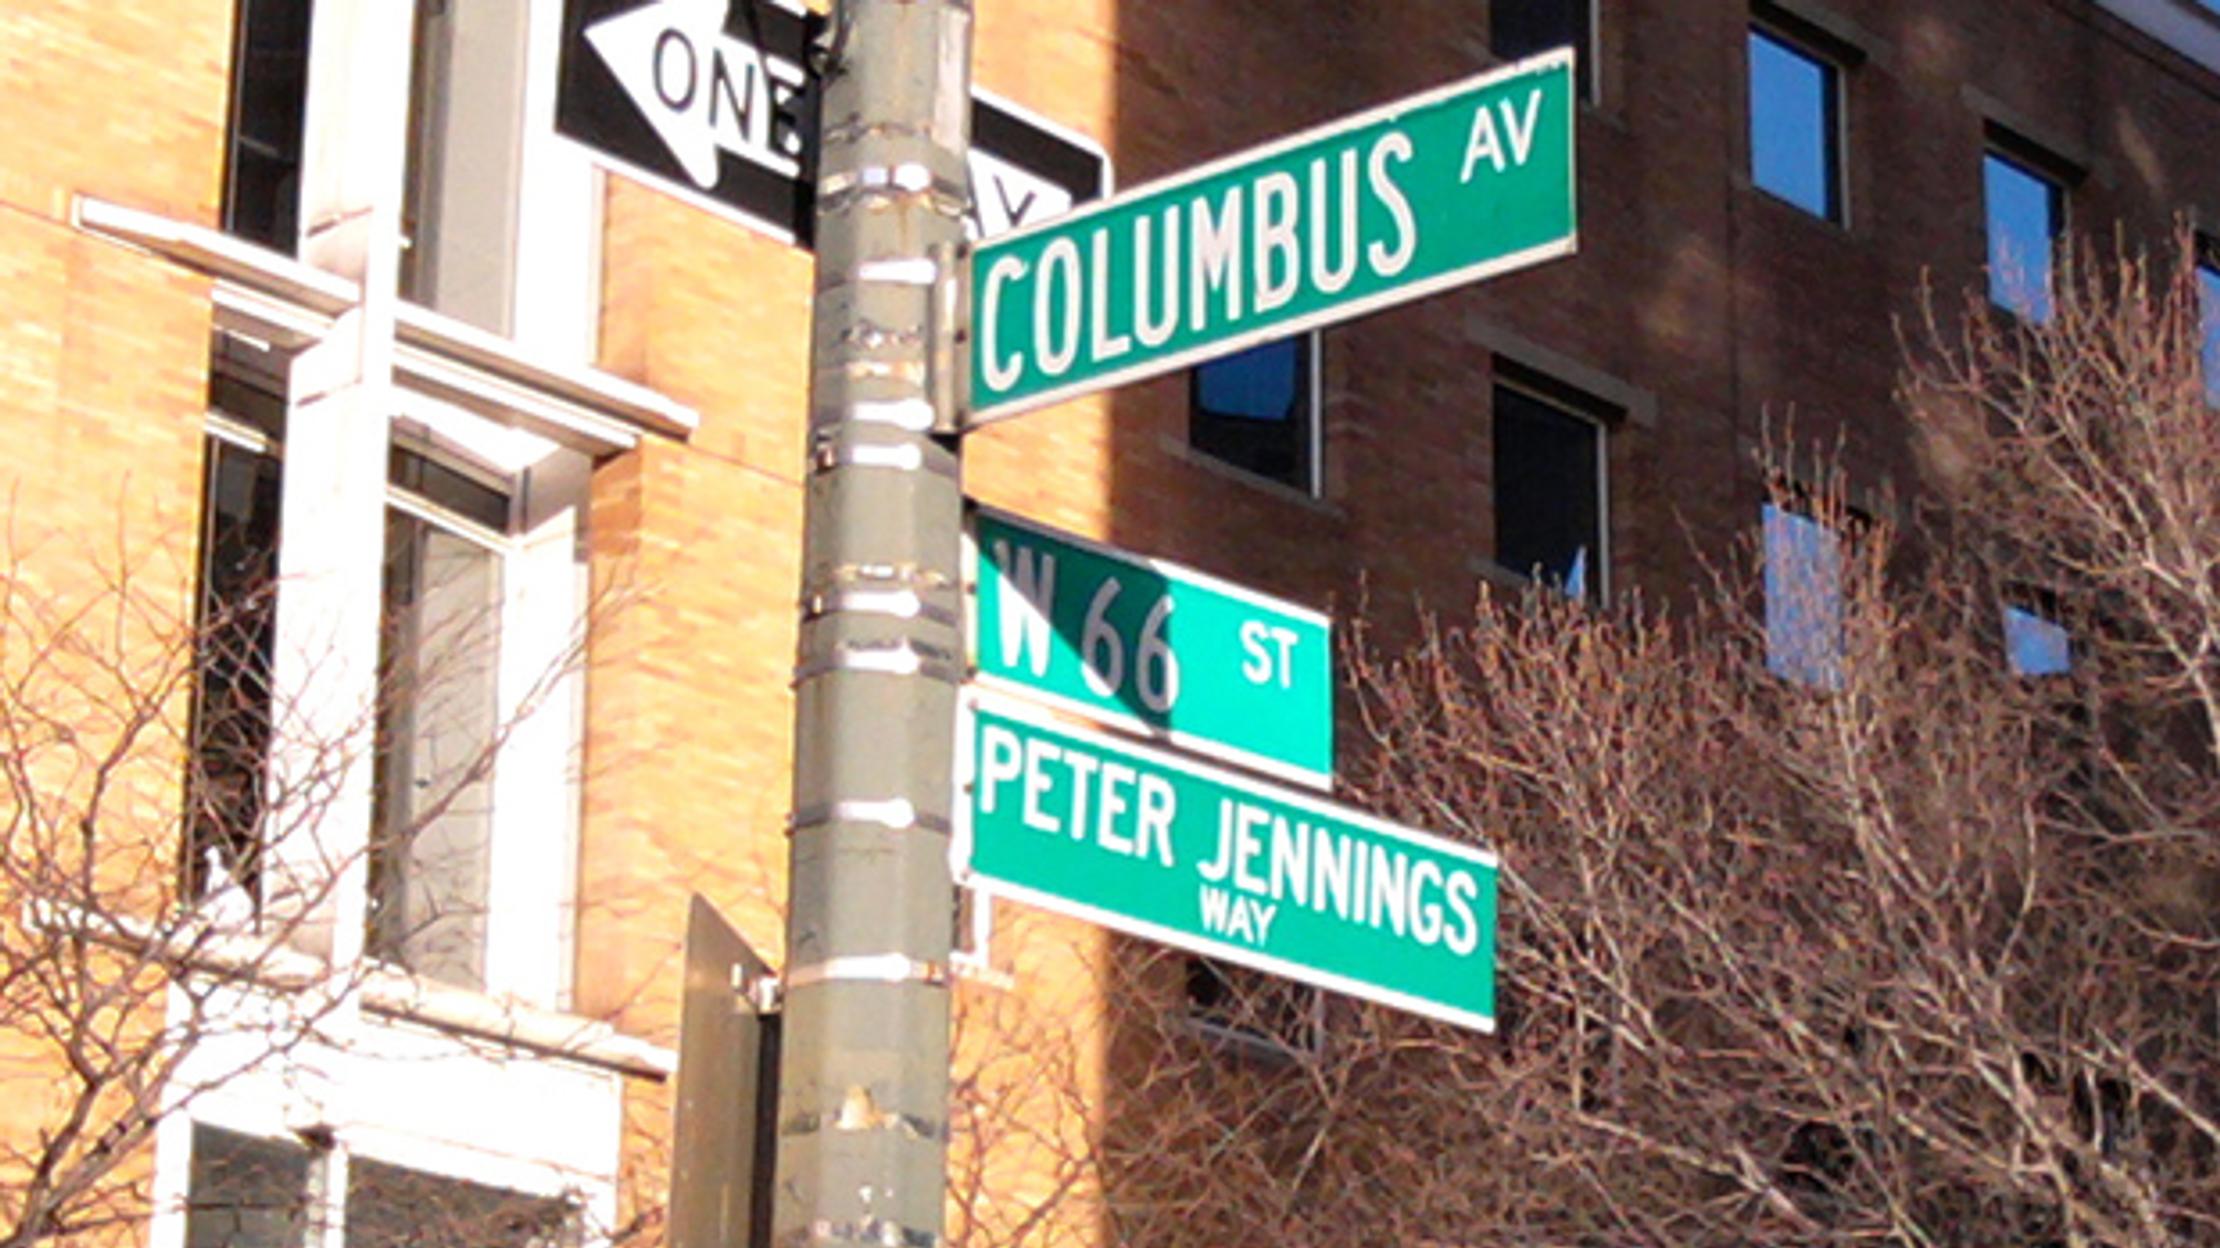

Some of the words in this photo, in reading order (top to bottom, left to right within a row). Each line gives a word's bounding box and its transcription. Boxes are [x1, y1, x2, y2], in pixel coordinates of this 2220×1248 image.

[652, 26, 803, 158] ONE
[981, 132, 1417, 392] COLUMBUS
[1460, 88, 1542, 185] AV
[994, 538, 1057, 677] W
[1081, 576, 1179, 713] 66
[1239, 619, 1299, 689] ST
[979, 723, 1177, 867] PETER
[1196, 797, 1479, 956] JENNINGS
[1199, 884, 1277, 947] WAY
